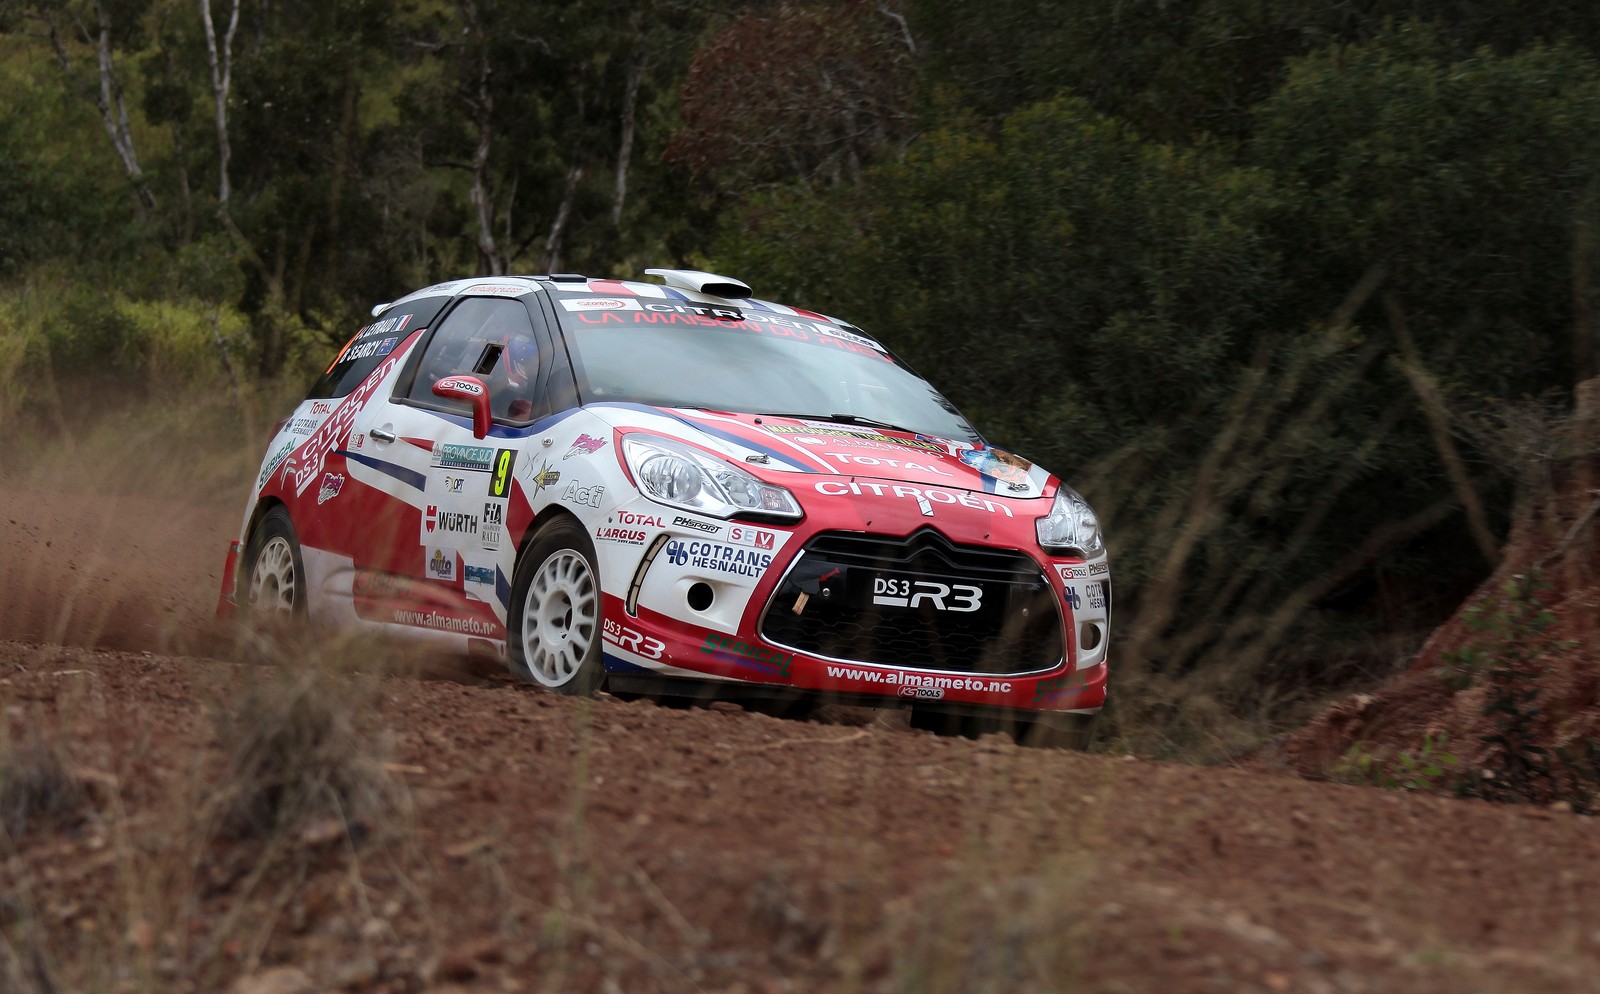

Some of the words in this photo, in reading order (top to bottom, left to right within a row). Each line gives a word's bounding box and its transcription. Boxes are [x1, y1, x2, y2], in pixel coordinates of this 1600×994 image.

[578, 312, 624, 324] LA
[634, 312, 762, 333] MAISON
[768, 324, 810, 341] DU
[346, 340, 383, 361] SEARCY
[456, 381, 479, 393] TOOLS
[310, 402, 332, 414] TOTAL
[294, 418, 318, 429] COTRANS
[442, 445, 478, 461] PROVINCE
[477, 449, 493, 462] SUD
[494, 450, 511, 496] 9
[825, 452, 954, 477] TOTAL
[561, 480, 605, 508] Acti
[439, 512, 478, 534] WÜRTH
[617, 510, 667, 529] TOTAL
[482, 531, 500, 543] RALLY
[596, 528, 647, 542] L'ARGUS
[430, 555, 452, 571] auto
[689, 541, 772, 569] COTRANS
[692, 558, 763, 578] HESNAULT
[1073, 568, 1086, 577] TOOLS
[701, 633, 793, 677] SERICAL
[827, 666, 1012, 693] www.almameto.nc
[917, 687, 941, 698] TOOLS
